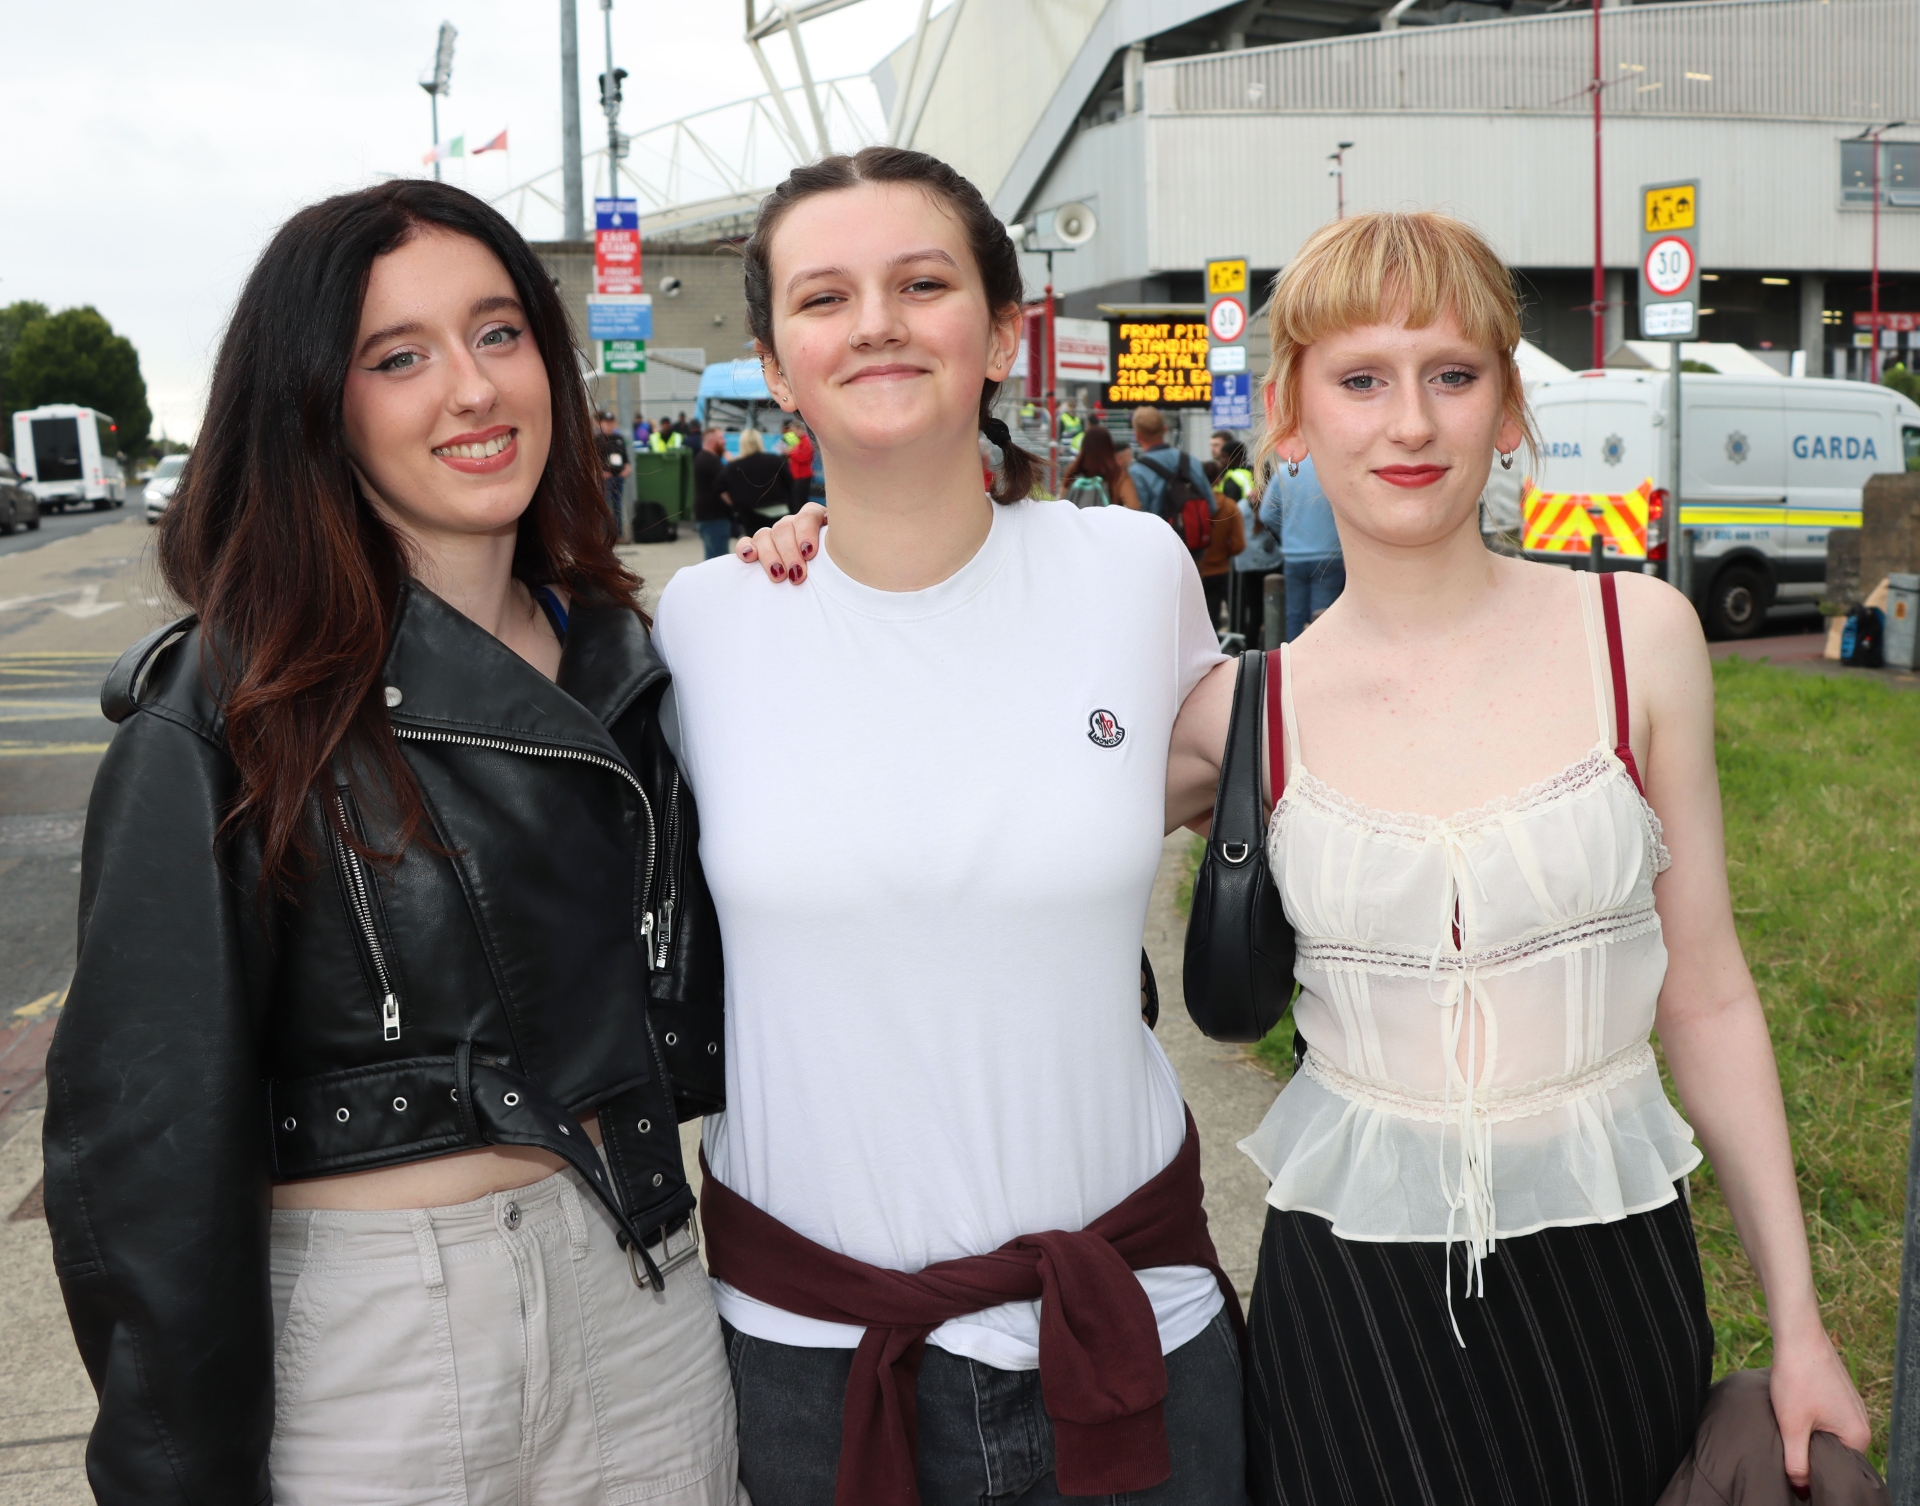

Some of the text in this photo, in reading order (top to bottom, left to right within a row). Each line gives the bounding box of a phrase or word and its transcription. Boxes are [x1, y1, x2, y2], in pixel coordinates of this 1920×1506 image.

[599, 242, 637, 253] STAND
[1658, 251, 1681, 275] 30
[1218, 307, 1237, 326] 30
[1120, 324, 1171, 340] FRONT
[1130, 339, 1209, 354] STANDING
[1117, 370, 1185, 385] 210-211
[1109, 386, 1160, 401] STAND
[1793, 435, 1878, 460] GARDA
[1093, 731, 1123, 745] MONCLER
